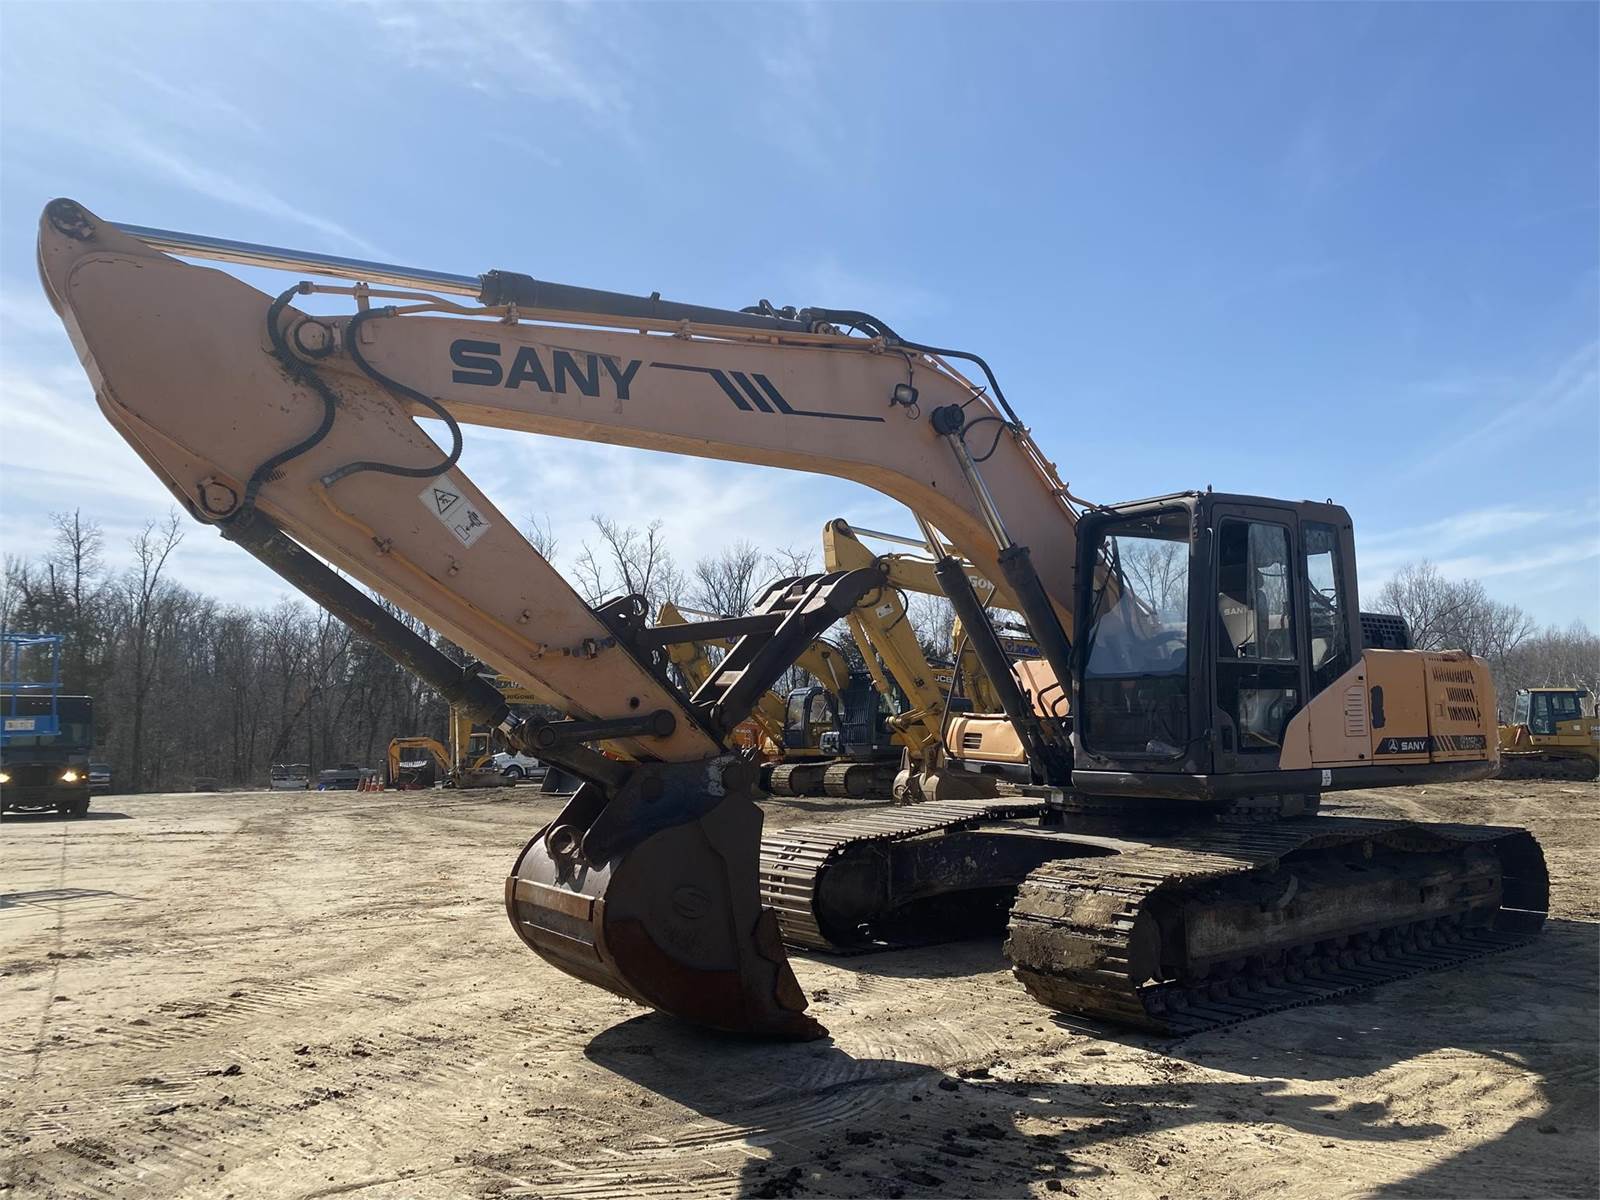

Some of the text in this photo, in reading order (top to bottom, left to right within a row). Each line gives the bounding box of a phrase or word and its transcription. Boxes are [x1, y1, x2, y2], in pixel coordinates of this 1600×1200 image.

[449, 338, 643, 400] SANY
[934, 674, 953, 683] JCB
[1401, 740, 1426, 751] SANY
